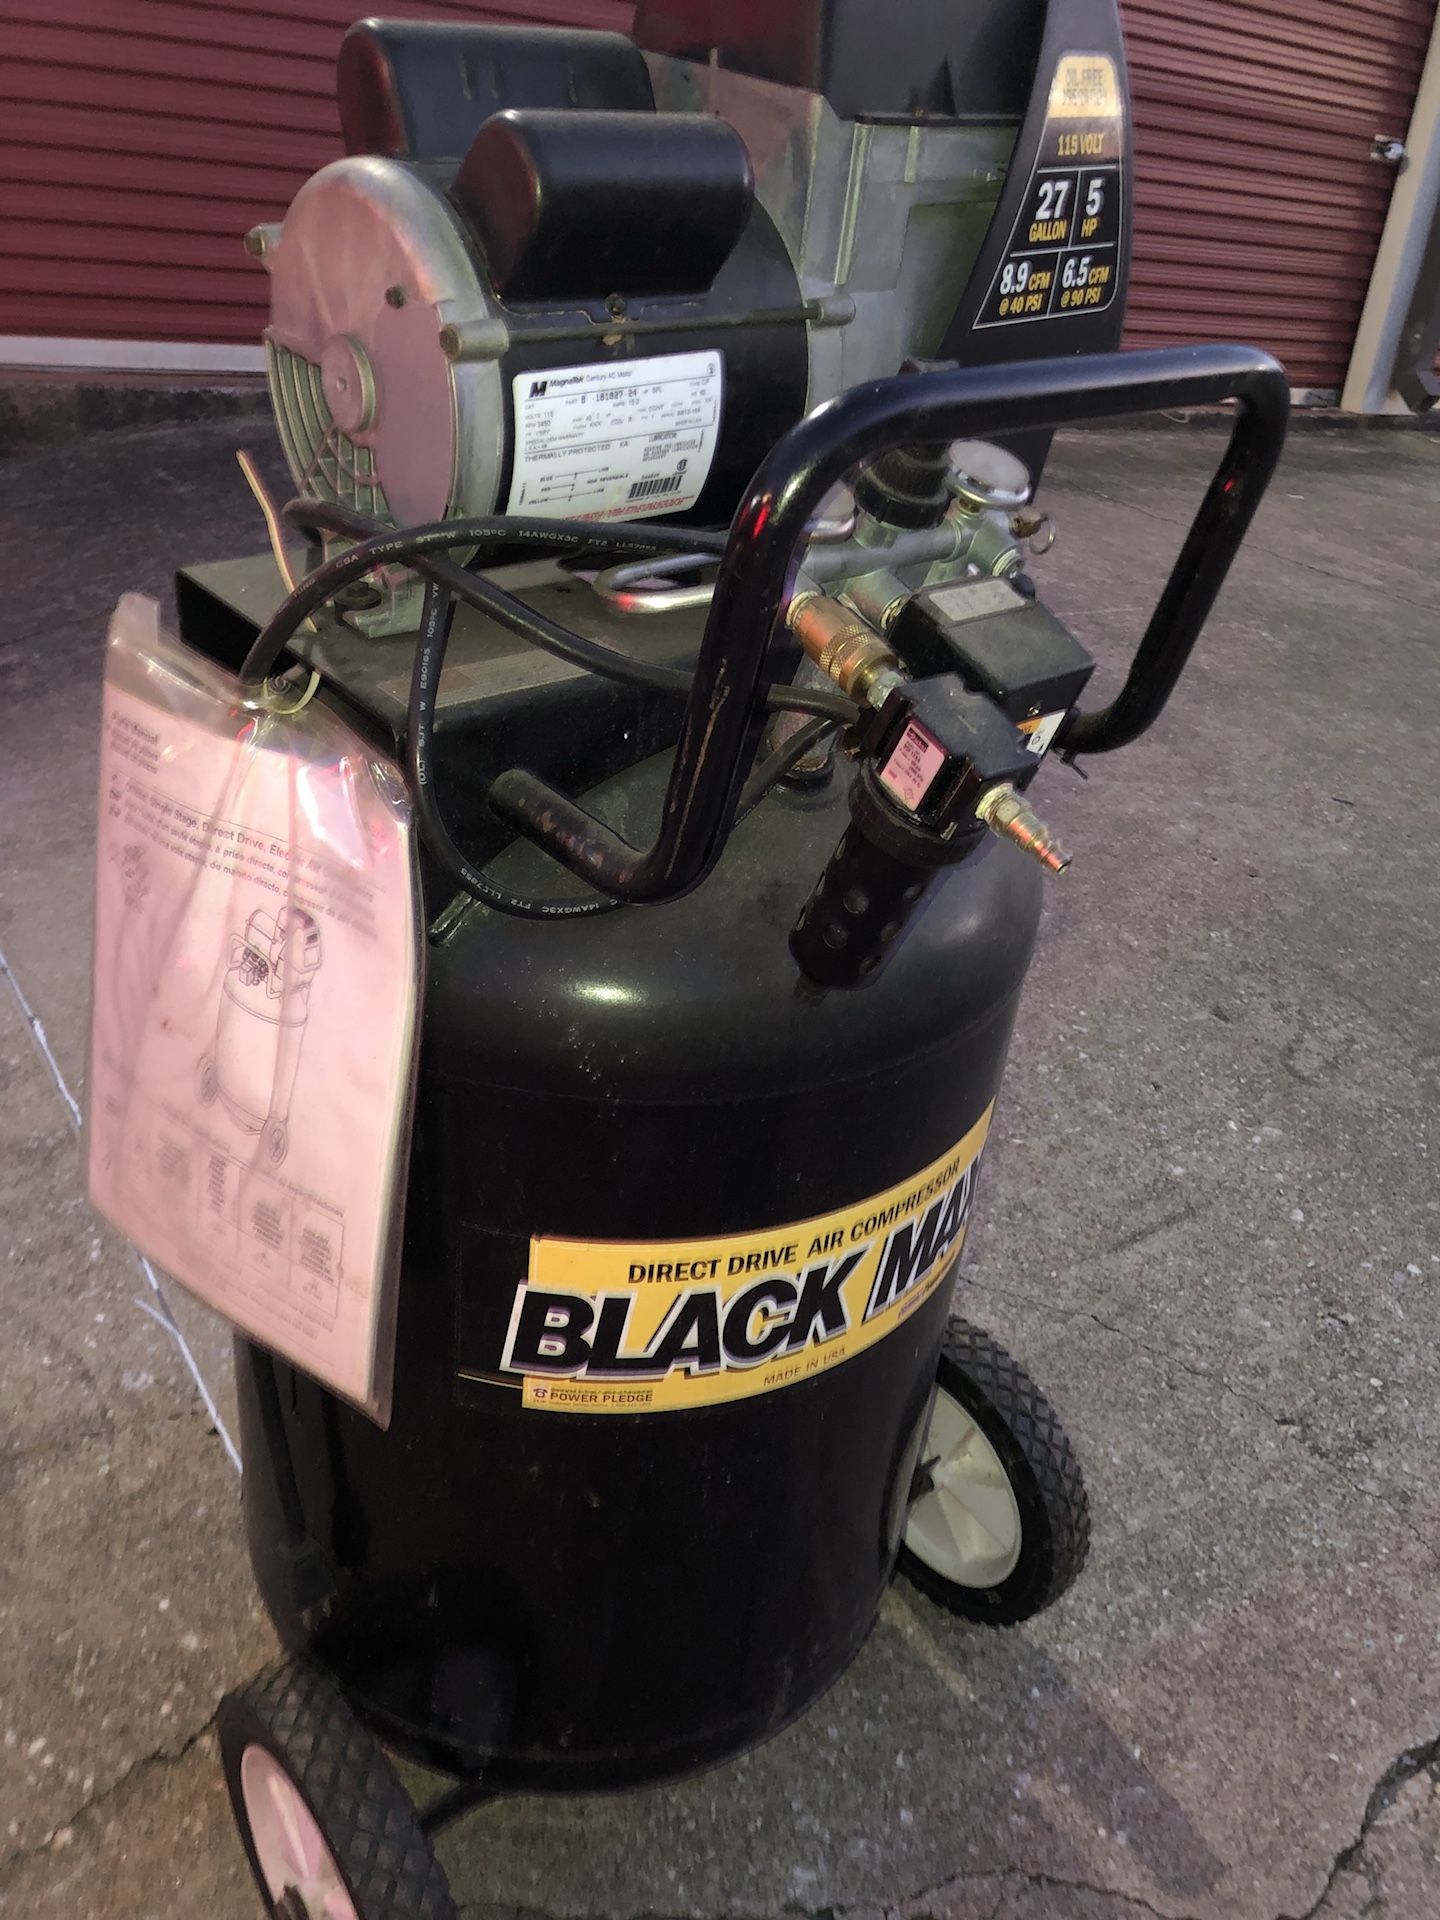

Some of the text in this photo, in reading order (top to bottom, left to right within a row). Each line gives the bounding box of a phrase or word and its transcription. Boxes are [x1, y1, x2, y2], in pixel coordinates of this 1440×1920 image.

[1058, 133, 1104, 156] 115 VOLT
[1036, 177, 1103, 221] 27 5
[1029, 217, 1098, 242] GALLON HP
[1000, 262, 1051, 296] 8.9 CFM
[1062, 256, 1111, 289] 6.5 CFM
[999, 295, 1043, 316] @ 40 PSI
[1060, 286, 1102, 309] @ 90 PSI
[525, 449, 567, 462] THERMALLY
[568, 443, 611, 456] PROTECTED
[335, 554, 359, 569] CSA
[369, 541, 403, 555] TYPE
[518, 530, 579, 544] 14AWGX3C
[419, 700, 427, 712] W
[202, 821, 235, 842] Drect
[236, 832, 267, 854] Drive,
[510, 897, 532, 909] FT2
[628, 1155, 961, 1285] DIRECT DRIVE AIR COMPRESSOR
[500, 1241, 874, 1381] BLACK
[763, 1343, 846, 1387] MADE IN USA
[550, 1392, 598, 1404] POWER
[602, 1393, 653, 1403] PLEDGE
